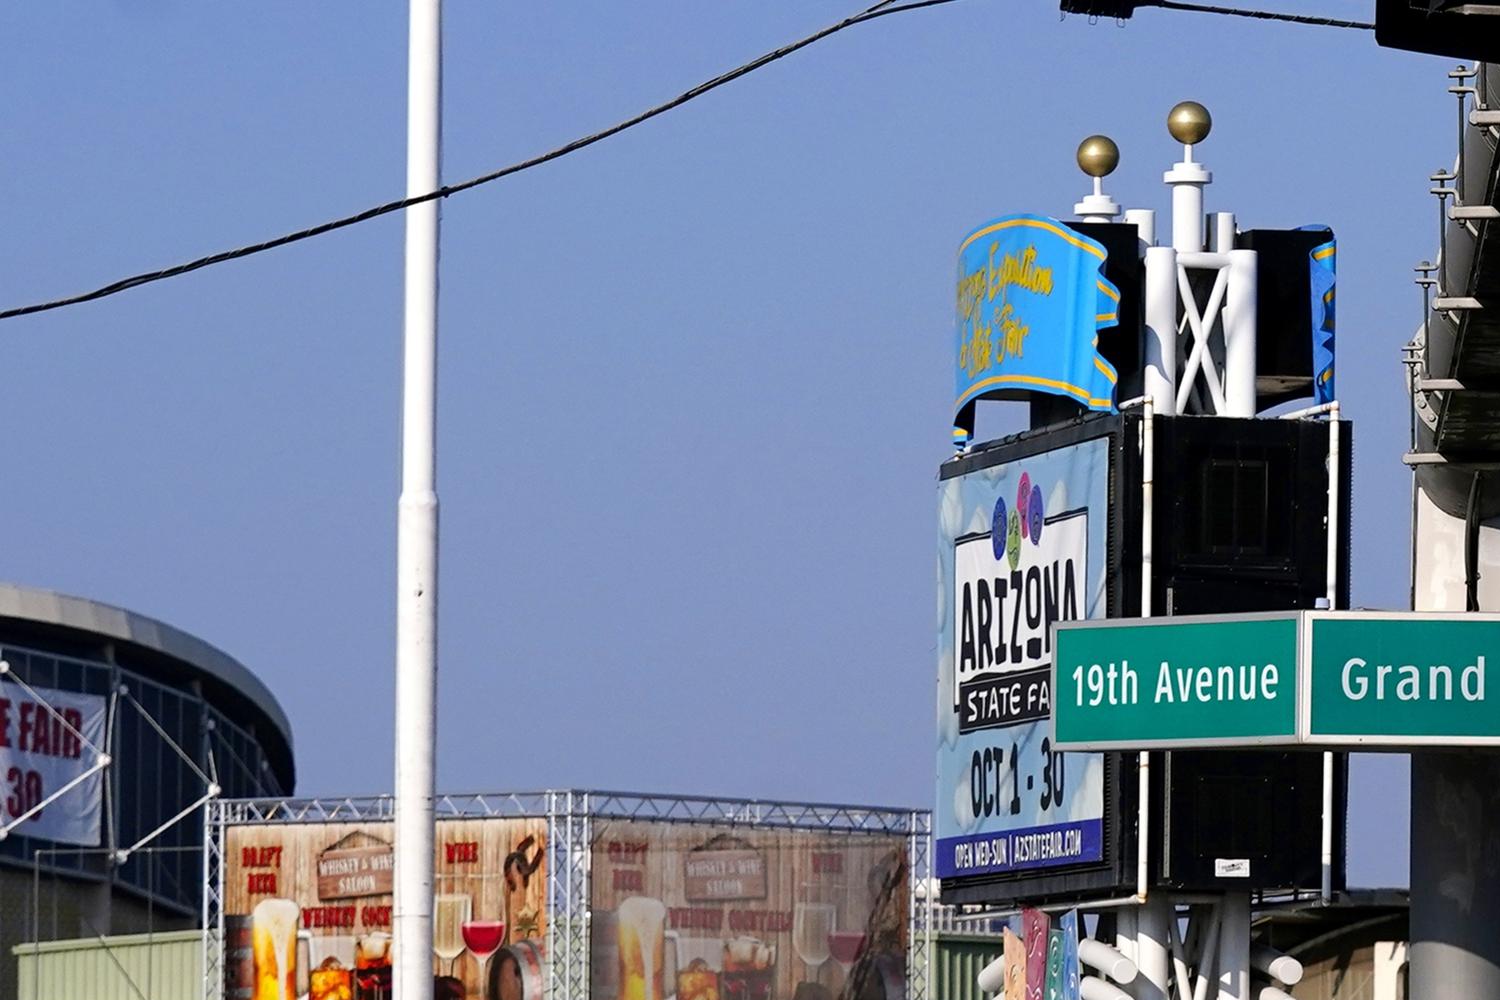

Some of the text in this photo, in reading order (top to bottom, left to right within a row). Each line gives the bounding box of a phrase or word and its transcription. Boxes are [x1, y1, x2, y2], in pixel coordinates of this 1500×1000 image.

[960, 558, 1078, 673] ARIZONA
[1072, 660, 1280, 706] 19th Avenue
[1341, 656, 1485, 701] Grand
[967, 680, 1050, 722] STATE FA
[19, 702, 82, 760] FAIR
[7, 766, 43, 822] 30
[971, 746, 1003, 819] OCT
[1040, 736, 1065, 811] 30
[242, 845, 283, 868] DRAFT
[318, 857, 359, 877] WHISKEY
[445, 840, 479, 865] WINE
[954, 843, 973, 869] OPEN
[975, 837, 1007, 867] WED-SUN
[1013, 829, 1082, 864] AZSTATEFAIR.COM
[247, 872, 277, 895] BEER
[338, 874, 376, 894] SALOON
[301, 905, 356, 929] WHISKEY
